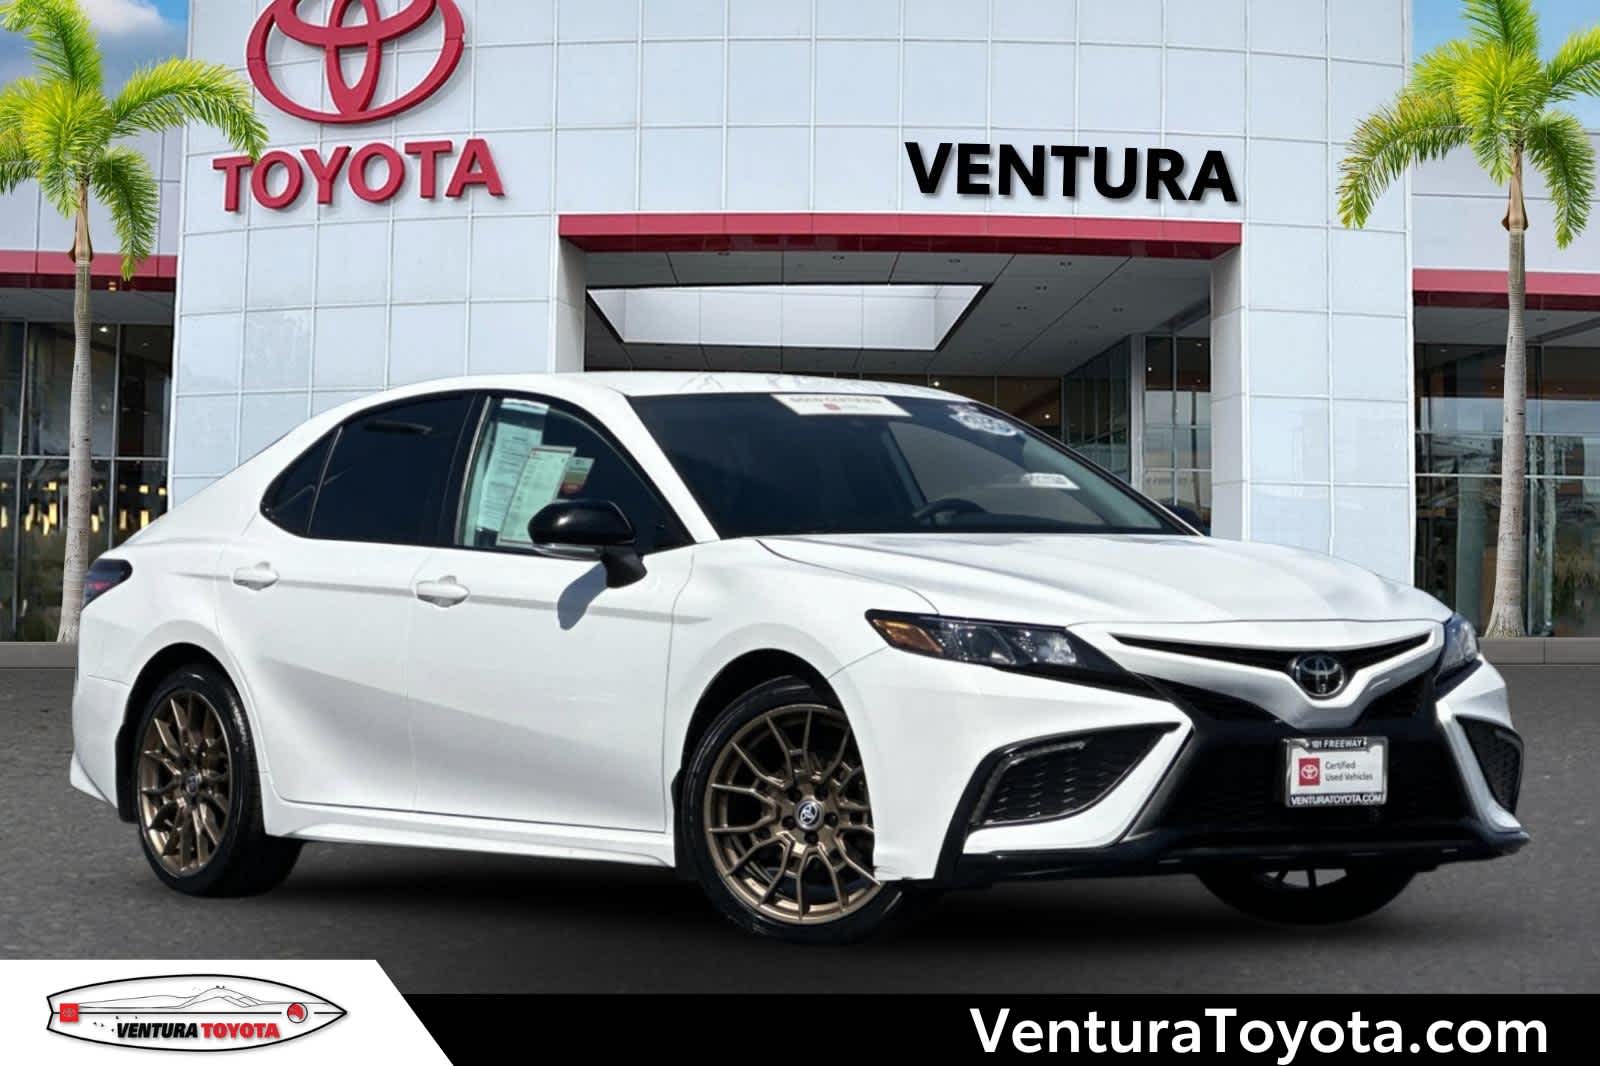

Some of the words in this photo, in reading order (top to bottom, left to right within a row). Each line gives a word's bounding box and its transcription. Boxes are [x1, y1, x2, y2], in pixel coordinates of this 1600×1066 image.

[212, 138, 506, 212] TOYOTA
[905, 141, 1239, 203] VENTURA
[1324, 739, 1363, 748] FREEWAY
[1325, 761, 1356, 770] Certified
[1325, 774, 1343, 782] Used
[1345, 773, 1373, 782] Vehicles
[1291, 794, 1382, 806] VENTURATOYOTA.COM
